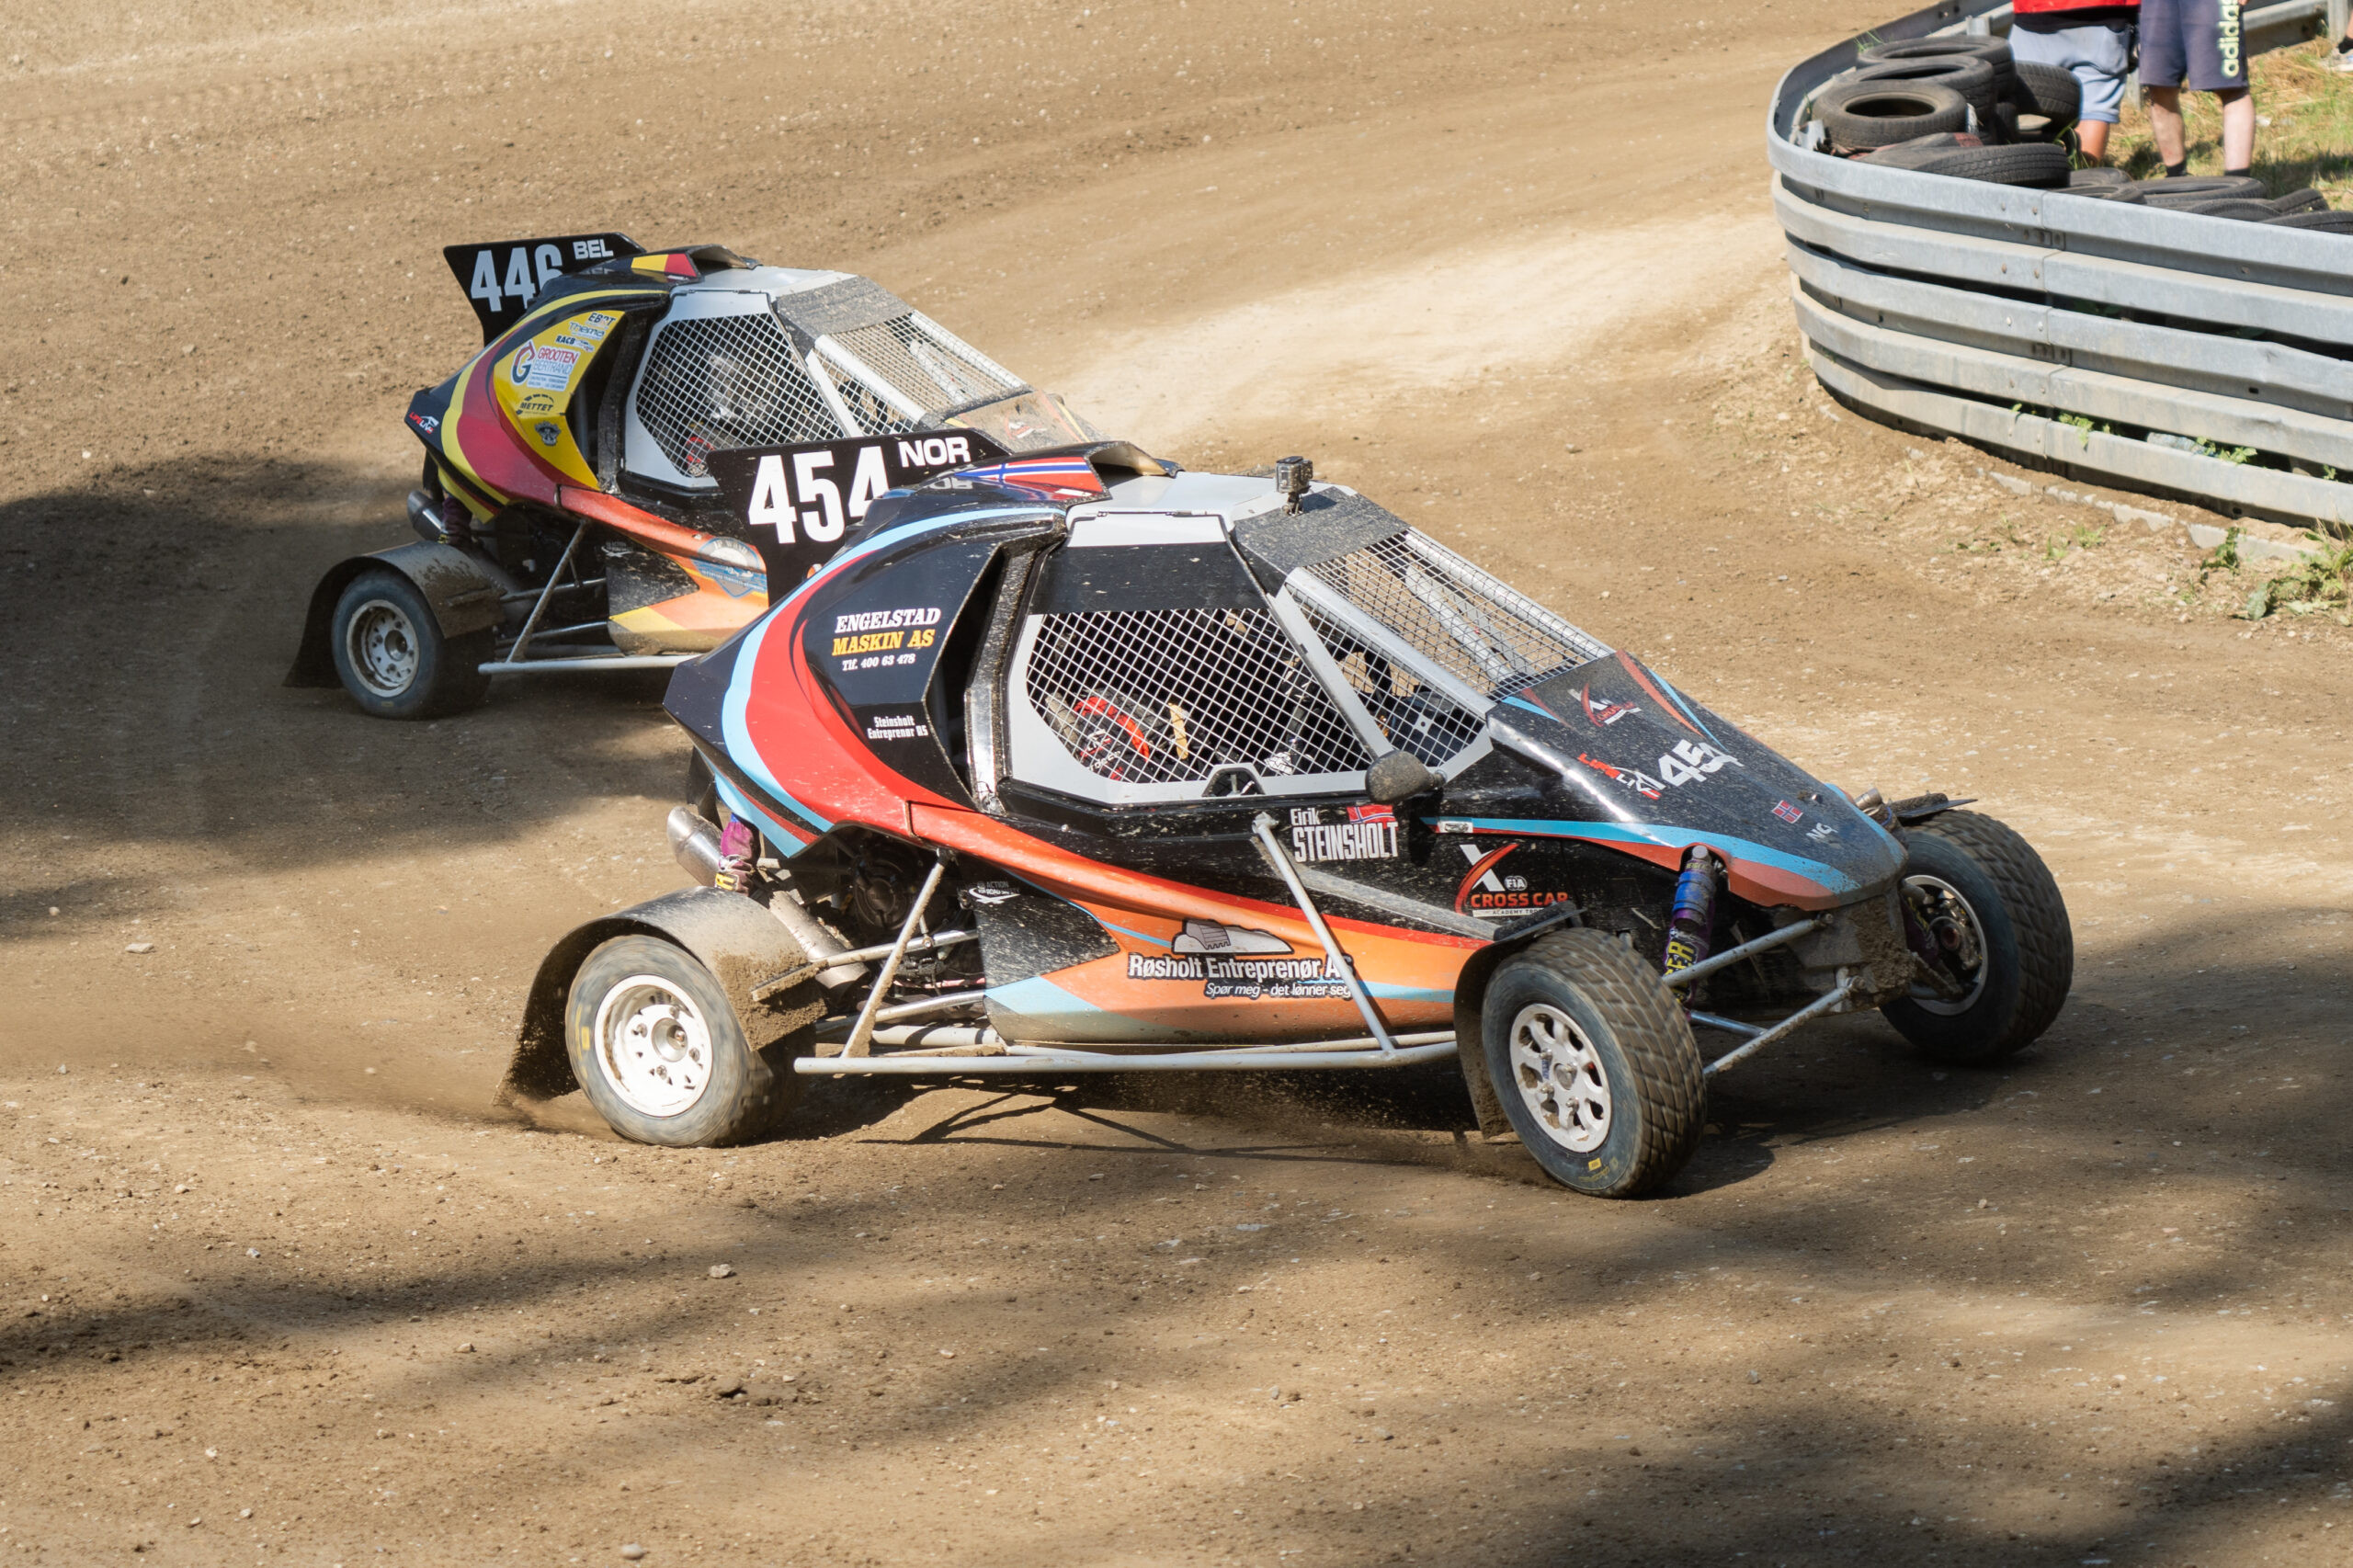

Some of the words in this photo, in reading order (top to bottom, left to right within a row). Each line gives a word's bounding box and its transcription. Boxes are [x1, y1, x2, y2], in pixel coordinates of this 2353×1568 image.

[573, 239, 615, 260] BEL
[471, 244, 563, 312] 446
[556, 335, 575, 345] RACB
[538, 347, 578, 365] GROOTEN
[533, 359, 572, 375] BERTRAND
[520, 402, 553, 412] METTET
[899, 437, 972, 467] NOR
[748, 446, 890, 544] 454
[835, 608, 941, 633] ENGELSTAD
[832, 631, 904, 656] MASKIN
[907, 629, 936, 647] AS
[860, 656, 880, 668] 400
[881, 655, 895, 666] 63
[897, 653, 916, 665] 478
[874, 715, 915, 727] Steinsholt
[1658, 739, 1745, 787] 454
[1290, 808, 1321, 826] Eirik
[1293, 822, 1398, 862] STEINSHOLT
[1506, 877, 1527, 889] FIA
[1471, 892, 1529, 908] CROSS
[1129, 954, 1203, 978] Røsholt
[1206, 957, 1321, 983] Entreprenør
[1206, 983, 1233, 997] Spør
[1234, 985, 1260, 998] meg
[1270, 983, 1290, 995] det
[1292, 983, 1328, 995] lønner
